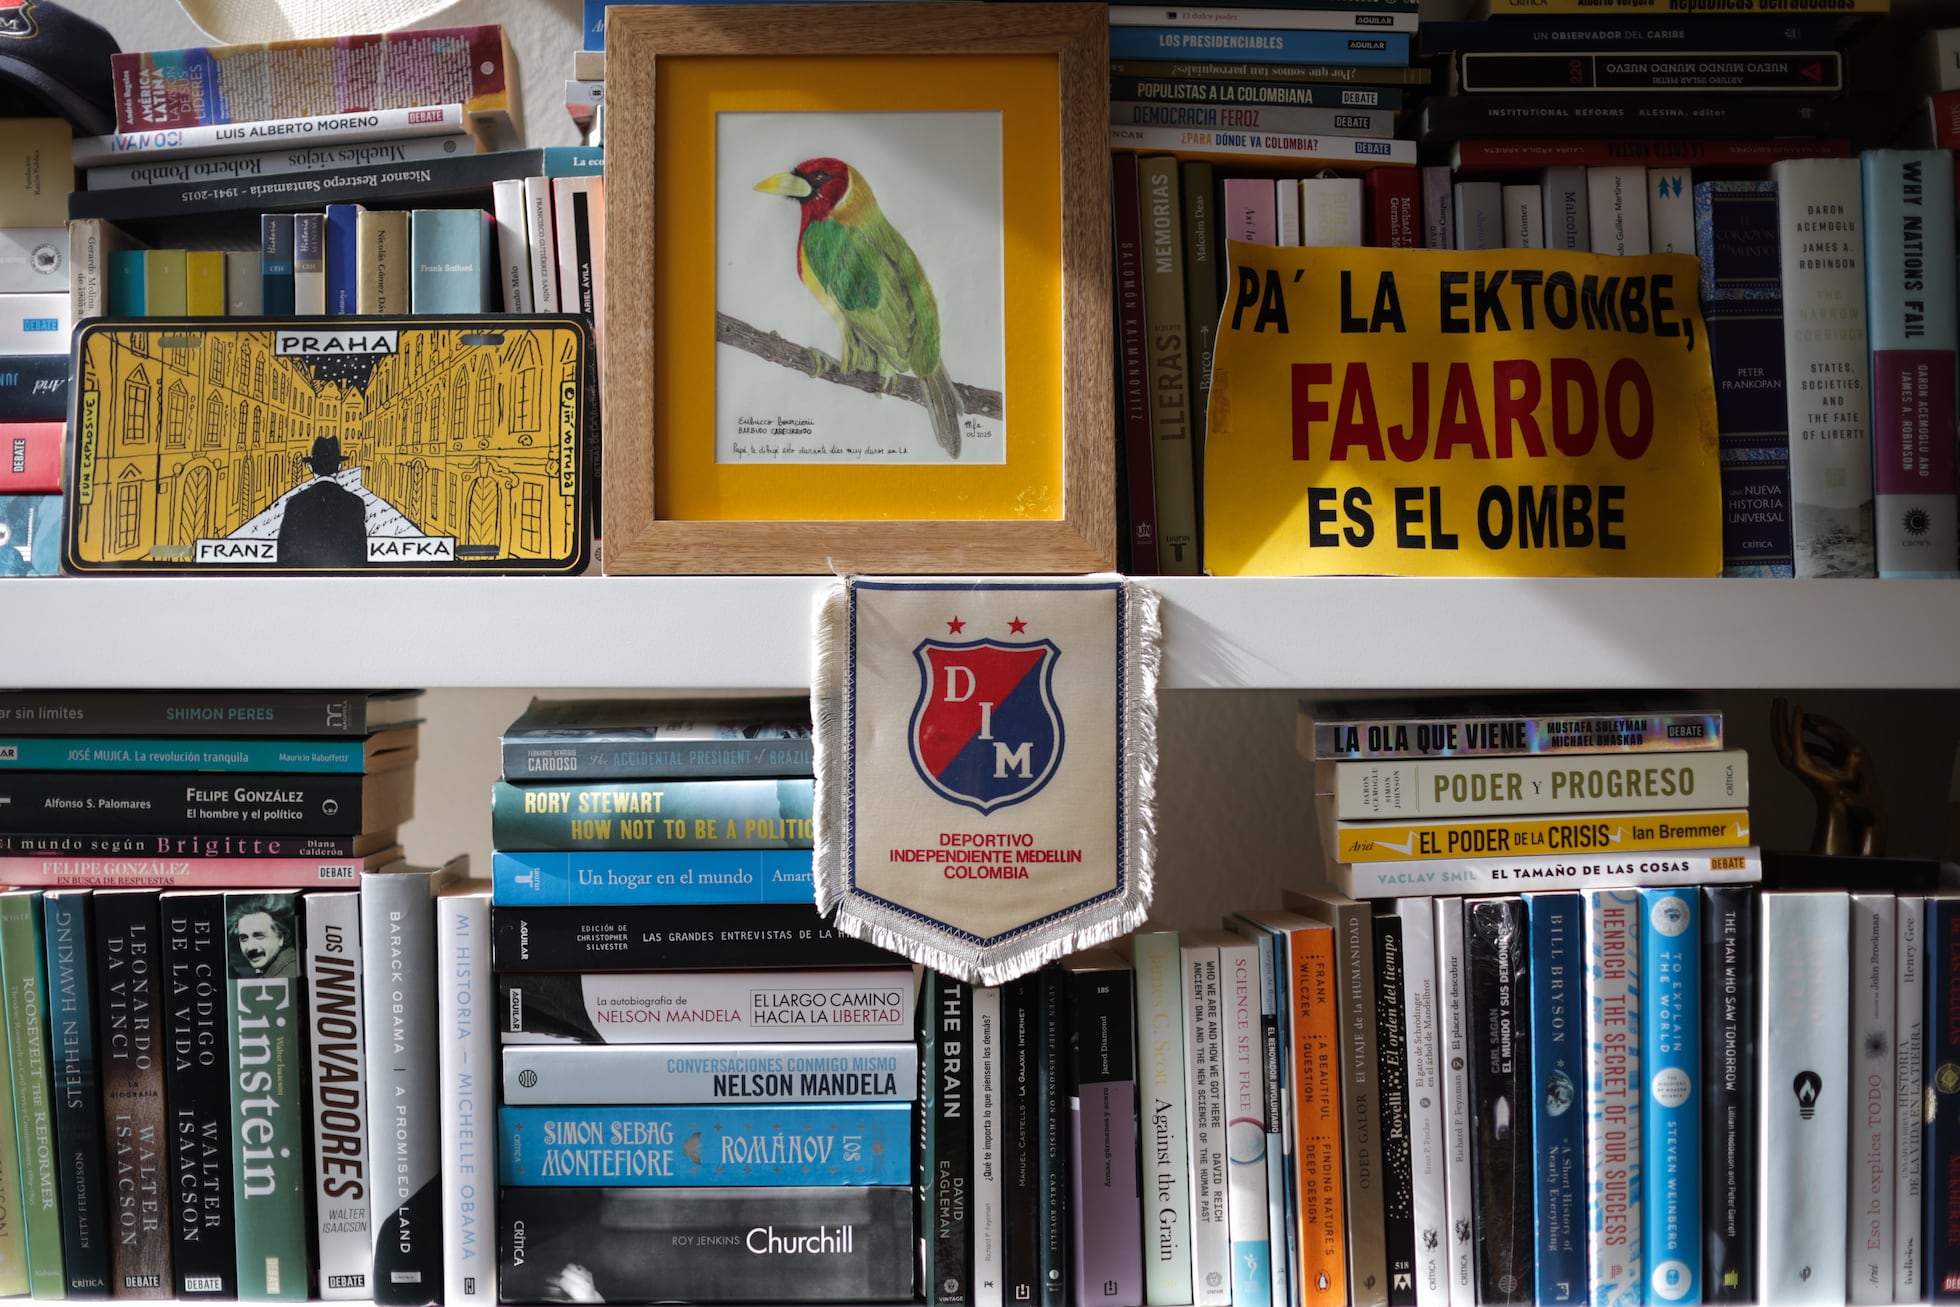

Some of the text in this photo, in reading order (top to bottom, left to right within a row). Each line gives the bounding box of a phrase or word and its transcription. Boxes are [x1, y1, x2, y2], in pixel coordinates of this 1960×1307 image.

[1357, 16, 1392, 25] AGUILAR
[1160, 35, 1283, 49] LOS PRESIDENCIABLES
[1350, 41, 1385, 49] AGUILAR
[1534, 29, 1685, 41] UN OBSERVADOR DEL CARIBE
[1607, 63, 1788, 73] NUEVO MUNDO MUNDO NUEVO
[140, 69, 153, 123] AMÉRICA
[152, 67, 168, 122] LATINA
[1138, 83, 1313, 104] POPULISTAS A LA COLOMBIANA
[1344, 92, 1377, 104] DEBATE
[409, 111, 442, 122] DEBATE
[1133, 106, 1260, 127] DEMOCRACIA FEROZ
[1336, 116, 1369, 128] DEBATE
[216, 115, 379, 140] LUIS ALBERTO MORENO
[1181, 132, 1319, 151] ¿PARA DÓNDE VA COLOMBIA?
[1356, 143, 1390, 154] DEBATE
[288, 144, 405, 168] Muebles viejos
[131, 158, 261, 182] Roberto Pombo
[381, 169, 431, 183] Nicanor
[251, 177, 320, 196] Santamaría
[324, 173, 378, 190] Restrepo
[182, 188, 238, 202] 1941-2015
[1151, 173, 1173, 273] MEMORIAS
[1902, 160, 1924, 338] WHY NATIONS FAIL
[1340, 271, 1406, 334] LA
[1440, 270, 1694, 353] EKTOMBE,
[281, 336, 391, 352] PRAHA
[1738, 367, 1765, 377] PETER
[1811, 363, 1855, 374] STATES,
[1156, 334, 1186, 440] LLERAS
[1722, 380, 1782, 390] FRANKOPAN
[1801, 380, 1864, 391] SOCIETIES,
[1291, 357, 1655, 463] FAJARDO
[1822, 396, 1844, 406] AND
[1808, 412, 1859, 423] THE FATE
[1803, 430, 1865, 440] OF LIBERTY
[13, 439, 25, 473] DEBATE
[82, 398, 95, 497] FUN EXPLOSIVE
[1307, 484, 1627, 551] ES EL OMBE
[201, 544, 274, 559] FRANZ
[370, 541, 450, 557] KAFKA
[166, 707, 274, 721] SHIMON PERES
[1334, 722, 1526, 753] LA OLA QUE VIENE
[67, 749, 249, 764] JOSÉ MUJICA. La revolución tranquila
[186, 785, 304, 803] FELIPE GONZÁLEZ
[1434, 767, 1695, 803] PODER Y PROGRESO
[525, 791, 664, 814] RORY STEWART
[186, 808, 303, 822] El hombre y el político
[571, 819, 610, 840] HOW
[620, 819, 655, 840] NOT
[664, 819, 687, 840] TO
[695, 819, 718, 839] BE
[726, 819, 737, 839] A
[1419, 824, 1610, 855] EL PODER DE LA CRISIS
[1632, 823, 1727, 840] Ian Bremmer
[157, 837, 282, 857] Brigitte
[939, 833, 1034, 847] DEPORTIVO
[890, 849, 1082, 863] INDEPENDIENTE MEDELLIN
[943, 865, 1029, 880] COLOMBIA
[1492, 861, 1690, 880] EL TAMAÑO DE LAS COSAS
[389, 911, 405, 1055] BARACK OBAMA
[108, 937, 129, 1060] DA VINCI
[130, 923, 151, 1070] LEONARDO
[754, 992, 900, 1007] EL LARGO CAMINO
[1725, 911, 1736, 1091] THE MAN WHO SAW TOMORROW
[56, 911, 83, 1109] STEPHEN HAWKING
[597, 1008, 741, 1024] NELSON MANDELA
[754, 1008, 900, 1024] HACIA LA LIBERTAD
[944, 984, 960, 1118] THE BRAIN
[314, 925, 364, 1200] LOS INNOVADORES
[667, 1057, 896, 1073] CONVERSACIONES CONMIGO MISMO
[713, 1073, 896, 1097] NELSON MANDELA
[1603, 908, 1627, 1246] HENRICH THE SECRET OF OUR SUCCESS
[236, 977, 290, 1200] Einstein
[543, 1121, 673, 1146] SIMON SEBAG
[721, 1133, 834, 1164] ROMÁNOV
[542, 1149, 673, 1177] MONTEFIORE
[116, 1115, 137, 1245] ISAACSON
[138, 1126, 158, 1232] WALTER
[1155, 1098, 1178, 1262] Against the Grain
[1667, 1121, 1677, 1250] STEVEN WEINBERG
[745, 1225, 853, 1254] Churchill
[328, 1275, 364, 1289] DEBATE
